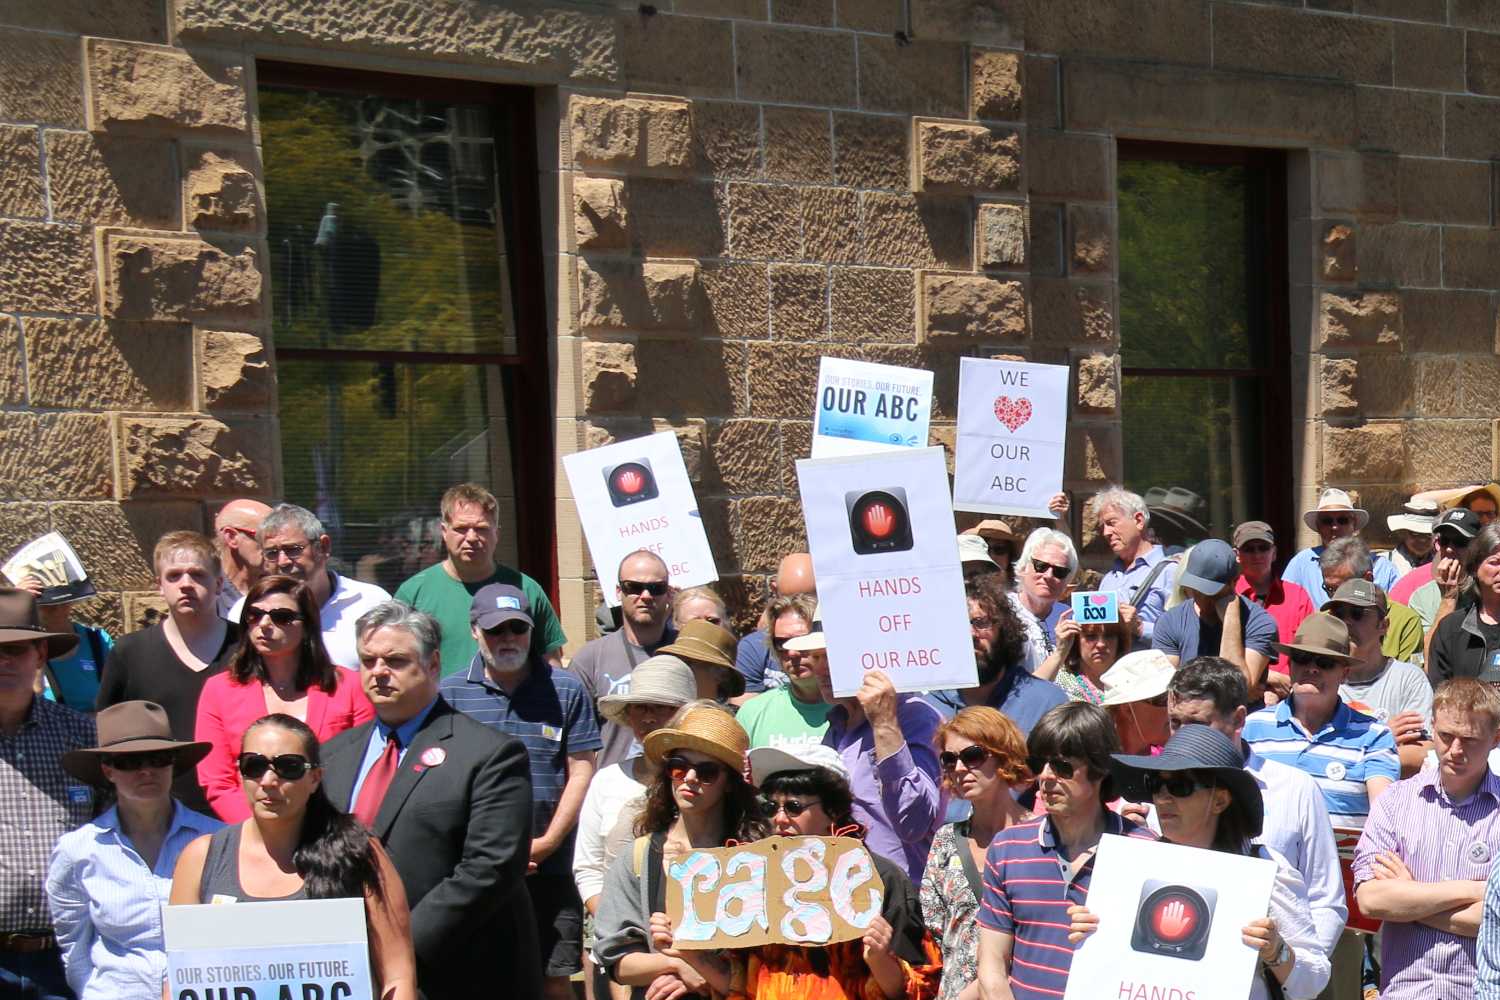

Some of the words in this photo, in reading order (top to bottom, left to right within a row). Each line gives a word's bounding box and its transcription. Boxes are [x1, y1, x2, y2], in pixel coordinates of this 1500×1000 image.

[824, 375, 840, 386] OUR
[876, 381, 890, 392] OUR
[1000, 370, 1029, 387] WE
[823, 386, 866, 416] OUR
[875, 393, 919, 422] ABC
[991, 443, 1030, 461] OUR
[990, 475, 1027, 493] ABC
[619, 516, 669, 538] HANDS
[638, 543, 664, 555] FF
[858, 576, 922, 598] HANDS
[1083, 595, 1090, 606] I
[879, 614, 912, 633] OFF
[861, 651, 901, 670] OUR
[906, 648, 942, 668] ABC
[669, 838, 883, 944] rage
[176, 967, 202, 985] OUR
[207, 964, 267, 984] STORIES.
[268, 962, 295, 981] OUR
[299, 960, 355, 979] FUTURE.
